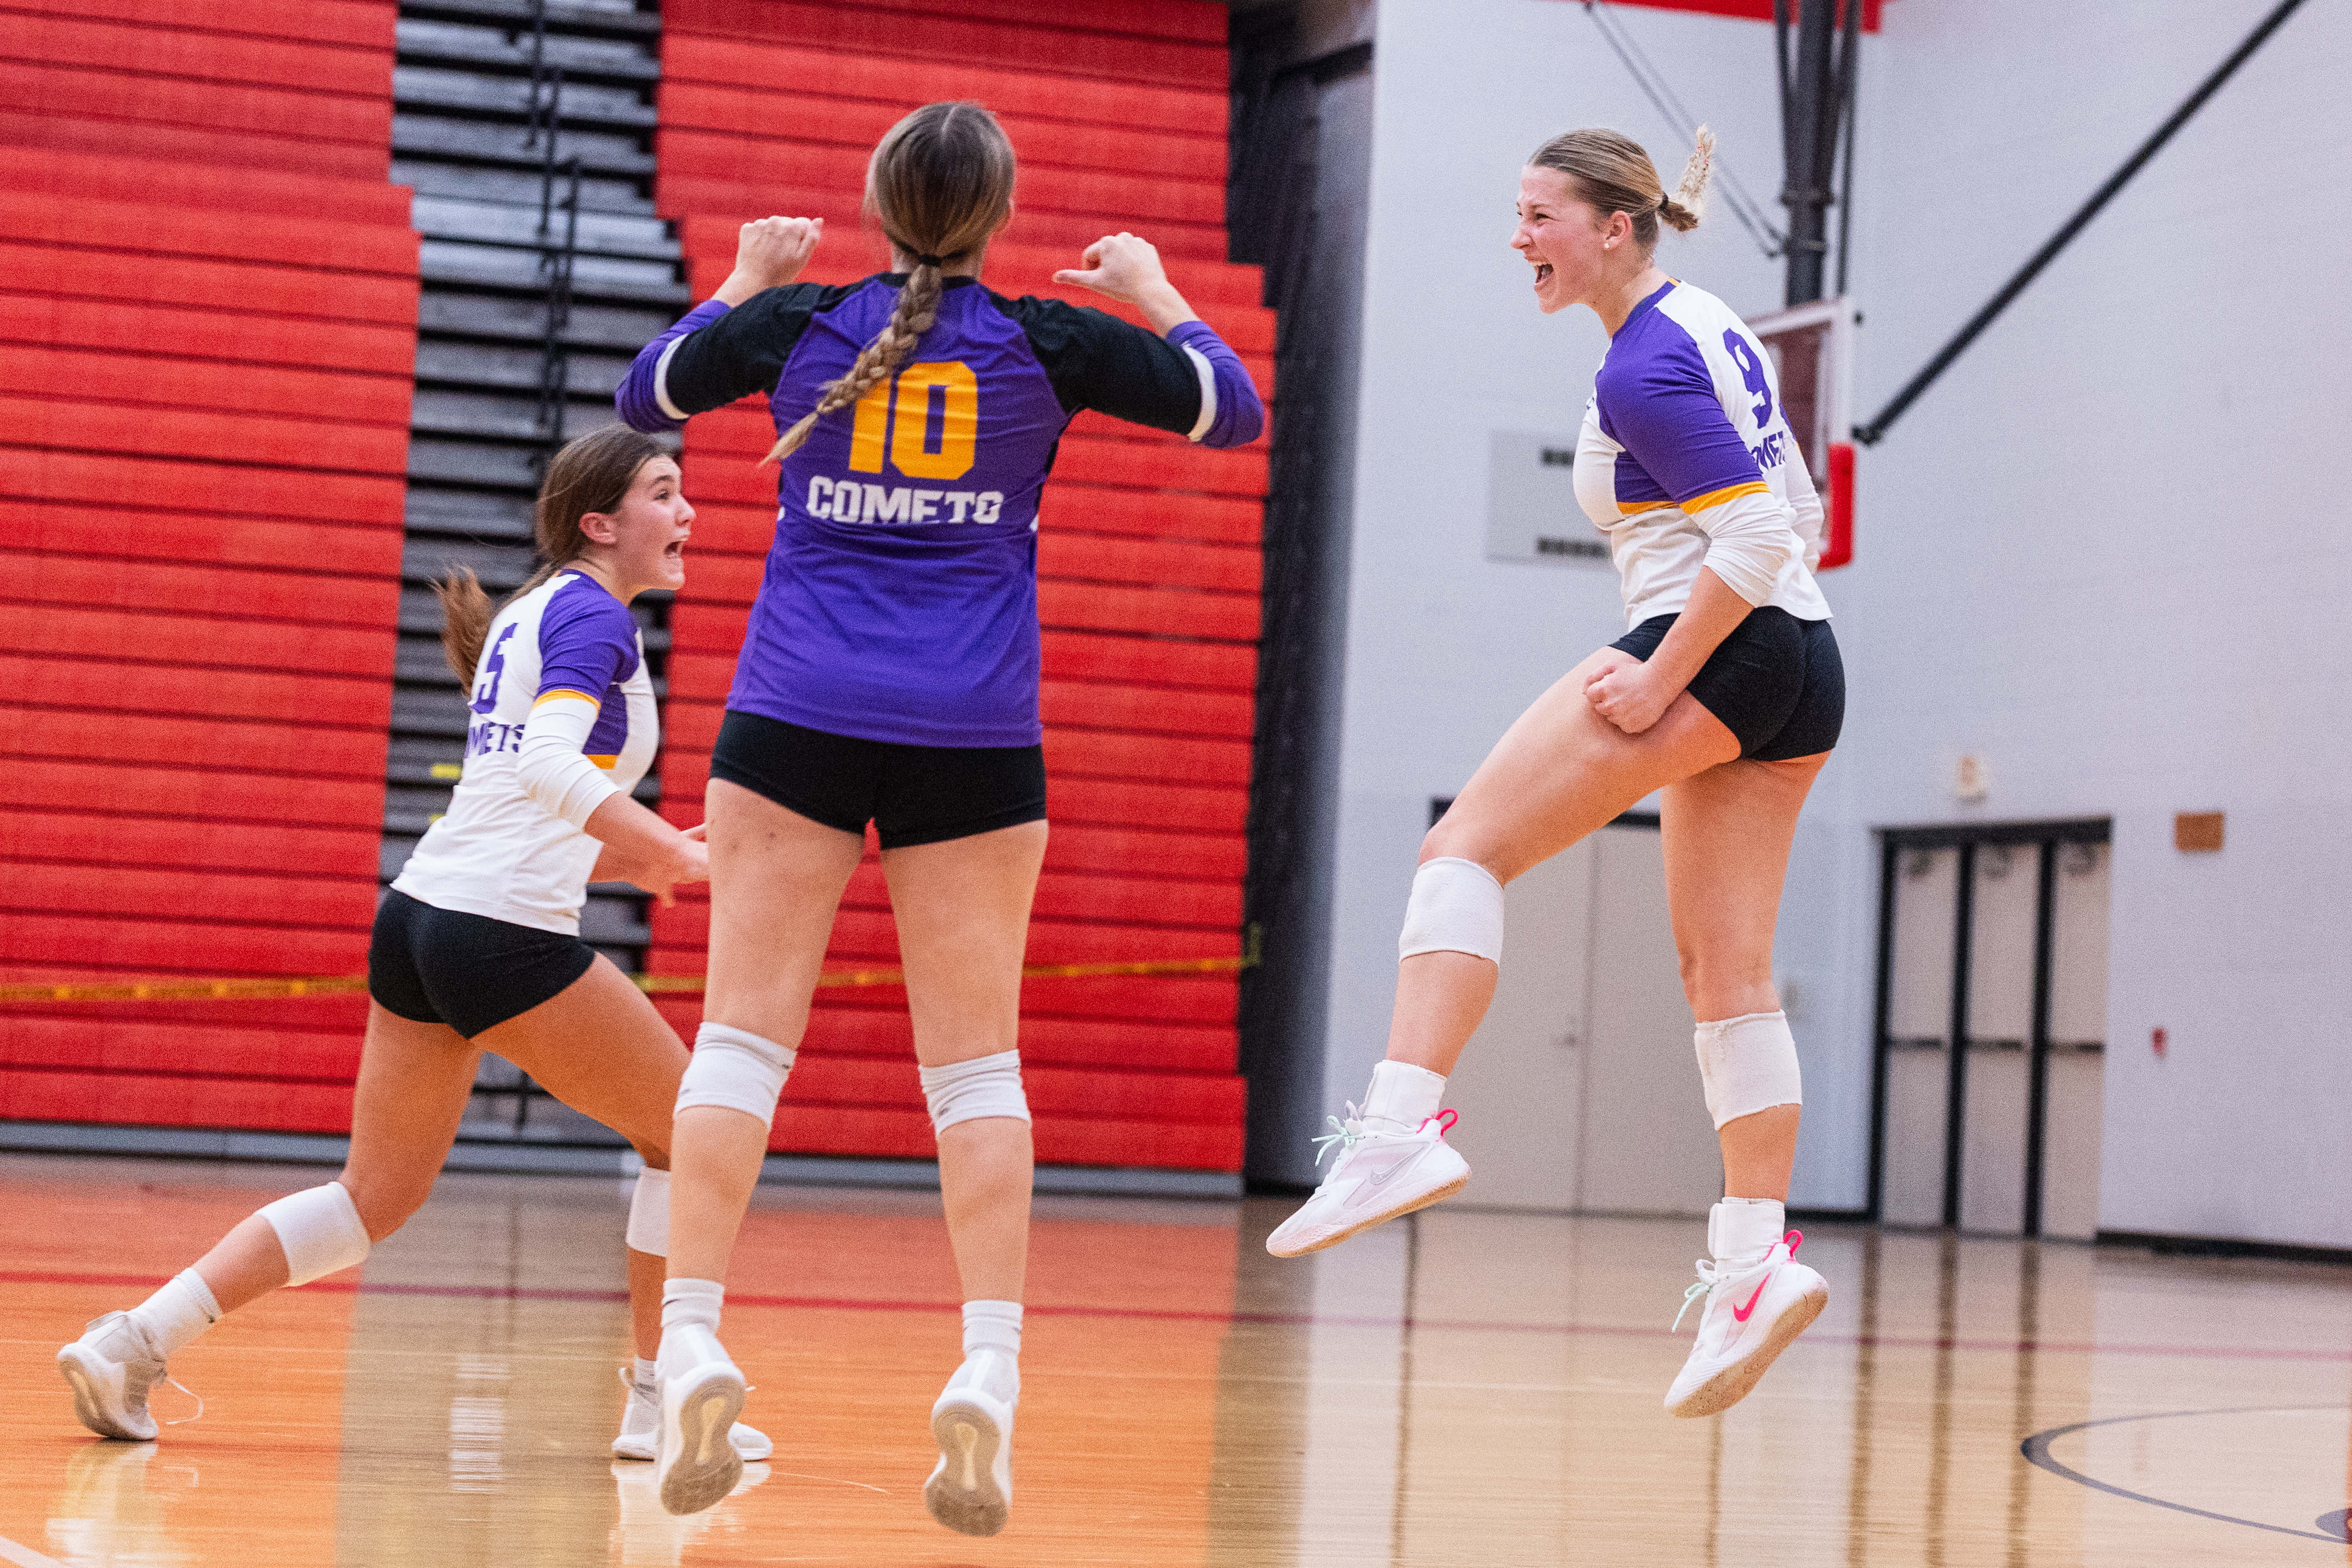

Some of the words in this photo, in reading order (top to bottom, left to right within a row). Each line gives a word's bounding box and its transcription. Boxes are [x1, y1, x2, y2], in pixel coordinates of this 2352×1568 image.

[849, 361, 978, 480] 10
[1723, 328, 1772, 429] 9
[806, 475, 1004, 524] COMETS
[469, 622, 518, 714] 5
